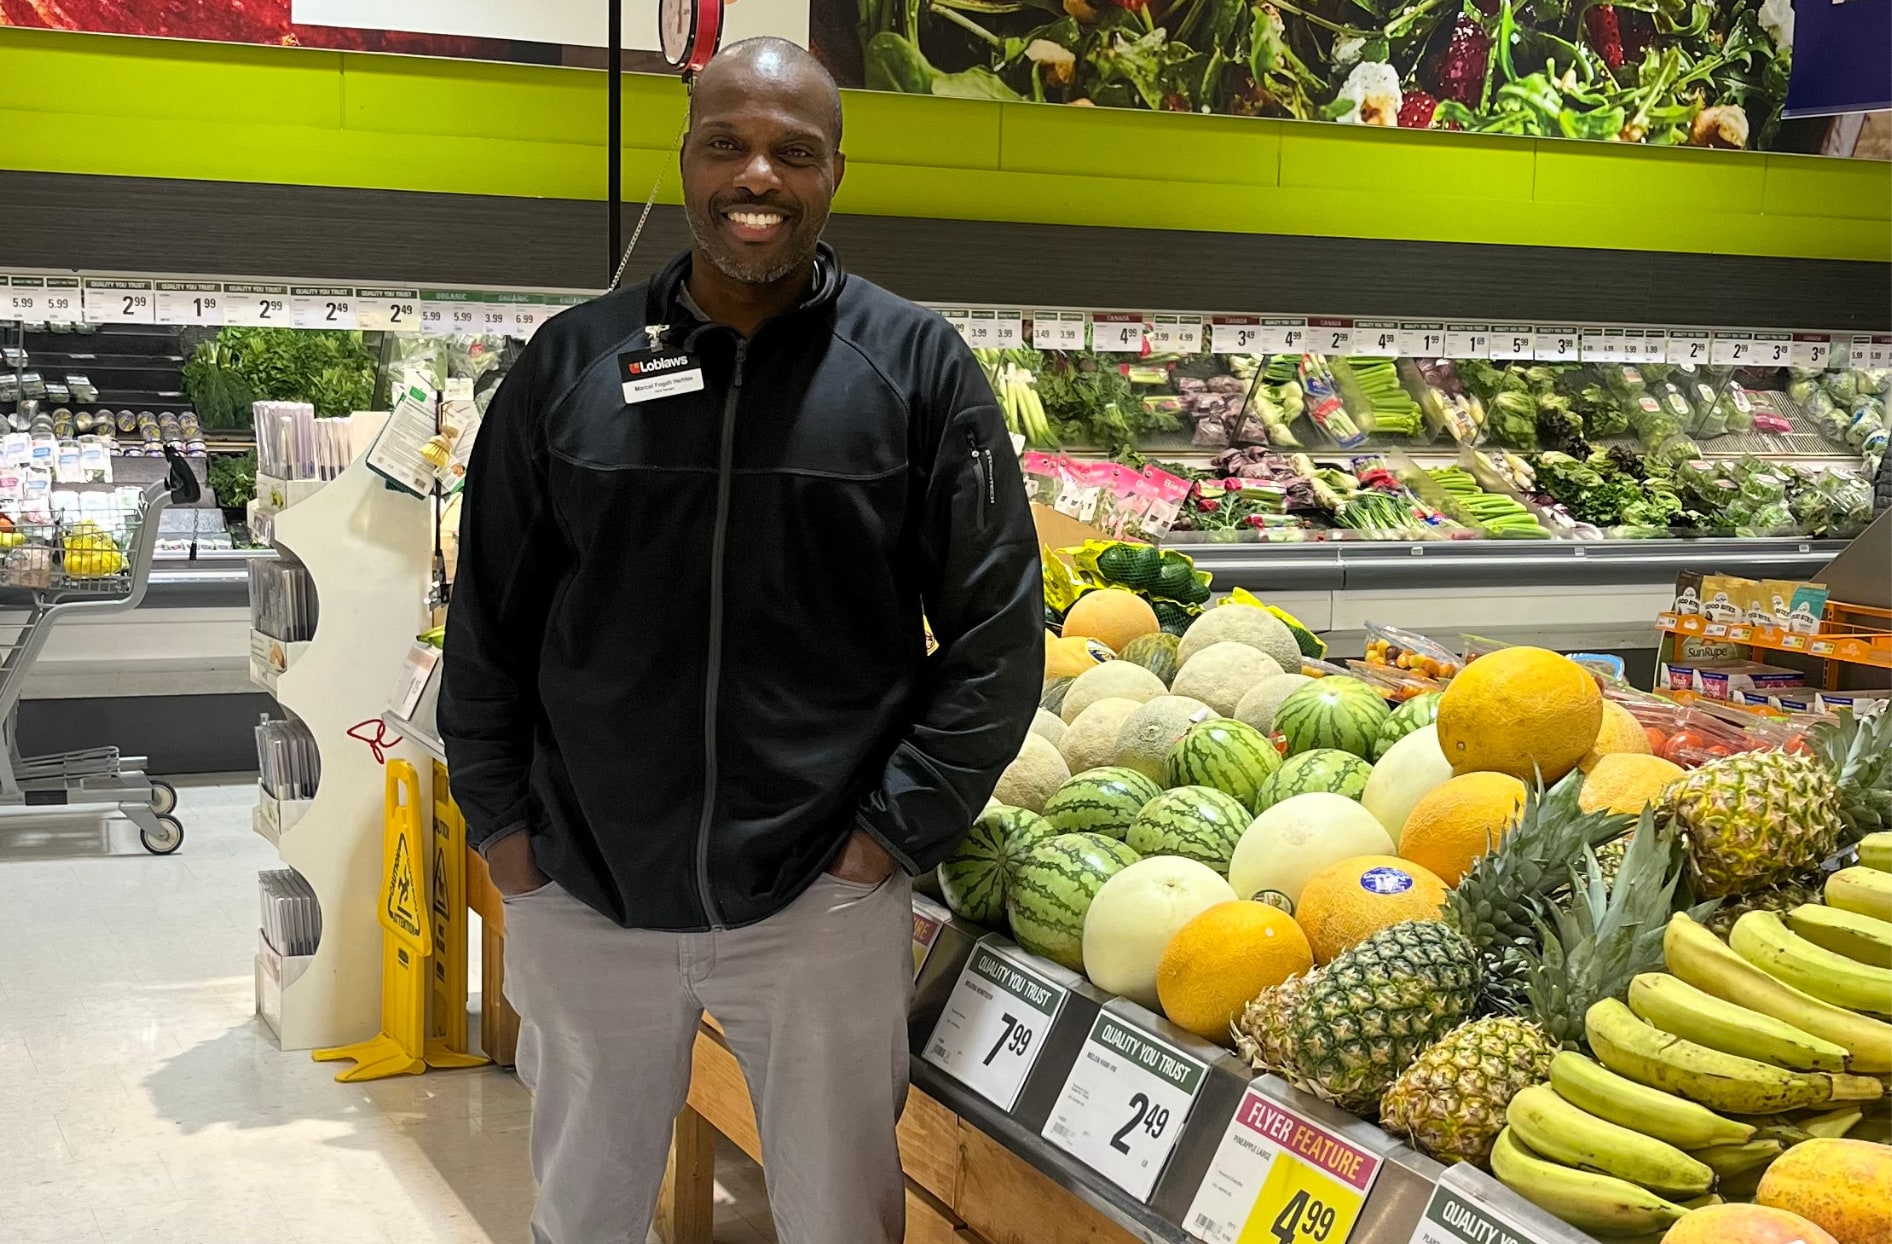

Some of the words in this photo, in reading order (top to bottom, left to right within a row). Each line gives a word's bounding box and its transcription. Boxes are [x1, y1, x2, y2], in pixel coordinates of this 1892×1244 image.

[12, 297, 33, 308] 5.99
[48, 298, 68, 308] 5.99
[422, 311, 440, 321] 5.99
[453, 312, 472, 322] 5.99
[484, 314, 502, 323] 3.99
[516, 315, 533, 323] 6.99
[972, 328, 987, 338] 3.99
[997, 329, 1012, 338] 3.99
[640, 356, 688, 373] Loblaws
[1688, 648, 1727, 660] SunRype
[978, 956, 1010, 982] QUALITY
[1008, 972, 1027, 992] YOU
[1024, 981, 1052, 1007] TRUST
[1102, 1024, 1141, 1056] QUALITY
[1138, 1043, 1160, 1066] YOU
[1158, 1054, 1192, 1083] TRUST
[1247, 1101, 1294, 1142] FLYER
[1292, 1125, 1364, 1181] FEATURE
[1233, 1134, 1257, 1152] PINEAPPLE
[1256, 1146, 1272, 1161] LARGE
[1442, 1200, 1499, 1244] QUALITY
